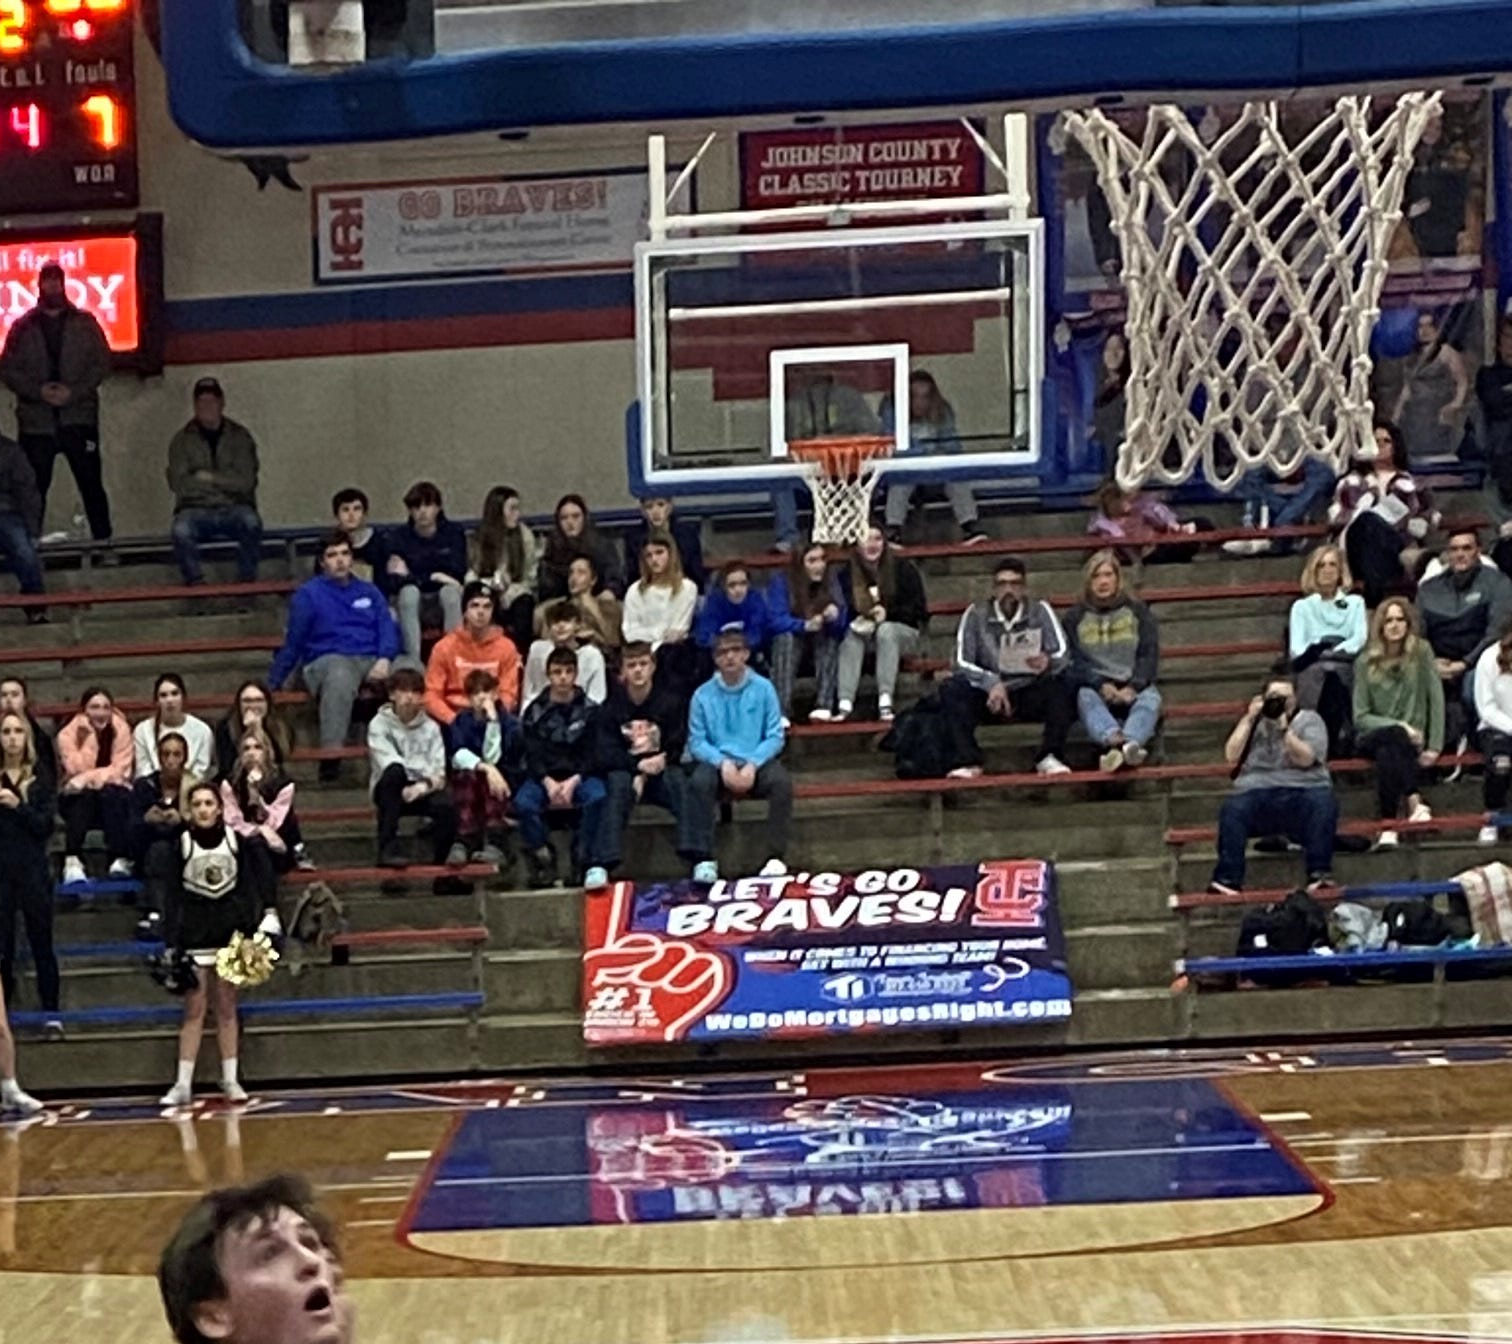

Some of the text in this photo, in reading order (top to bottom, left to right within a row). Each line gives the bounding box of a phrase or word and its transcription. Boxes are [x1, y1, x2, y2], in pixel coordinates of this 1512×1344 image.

[66, 59, 118, 84] fouls
[9, 102, 41, 149] 4
[84, 94, 118, 149] 7
[760, 137, 962, 169] JOHNSON COUNTY
[73, 164, 116, 184] won
[758, 165, 964, 196] CLASSIC TOURNEY
[398, 180, 609, 221] GO BRAVES!
[708, 867, 920, 904] LET'S GO
[666, 888, 967, 936] BRAVES!
[587, 986, 654, 1011] #1
[704, 998, 1073, 1031] WeDoMortgagesRight.com
